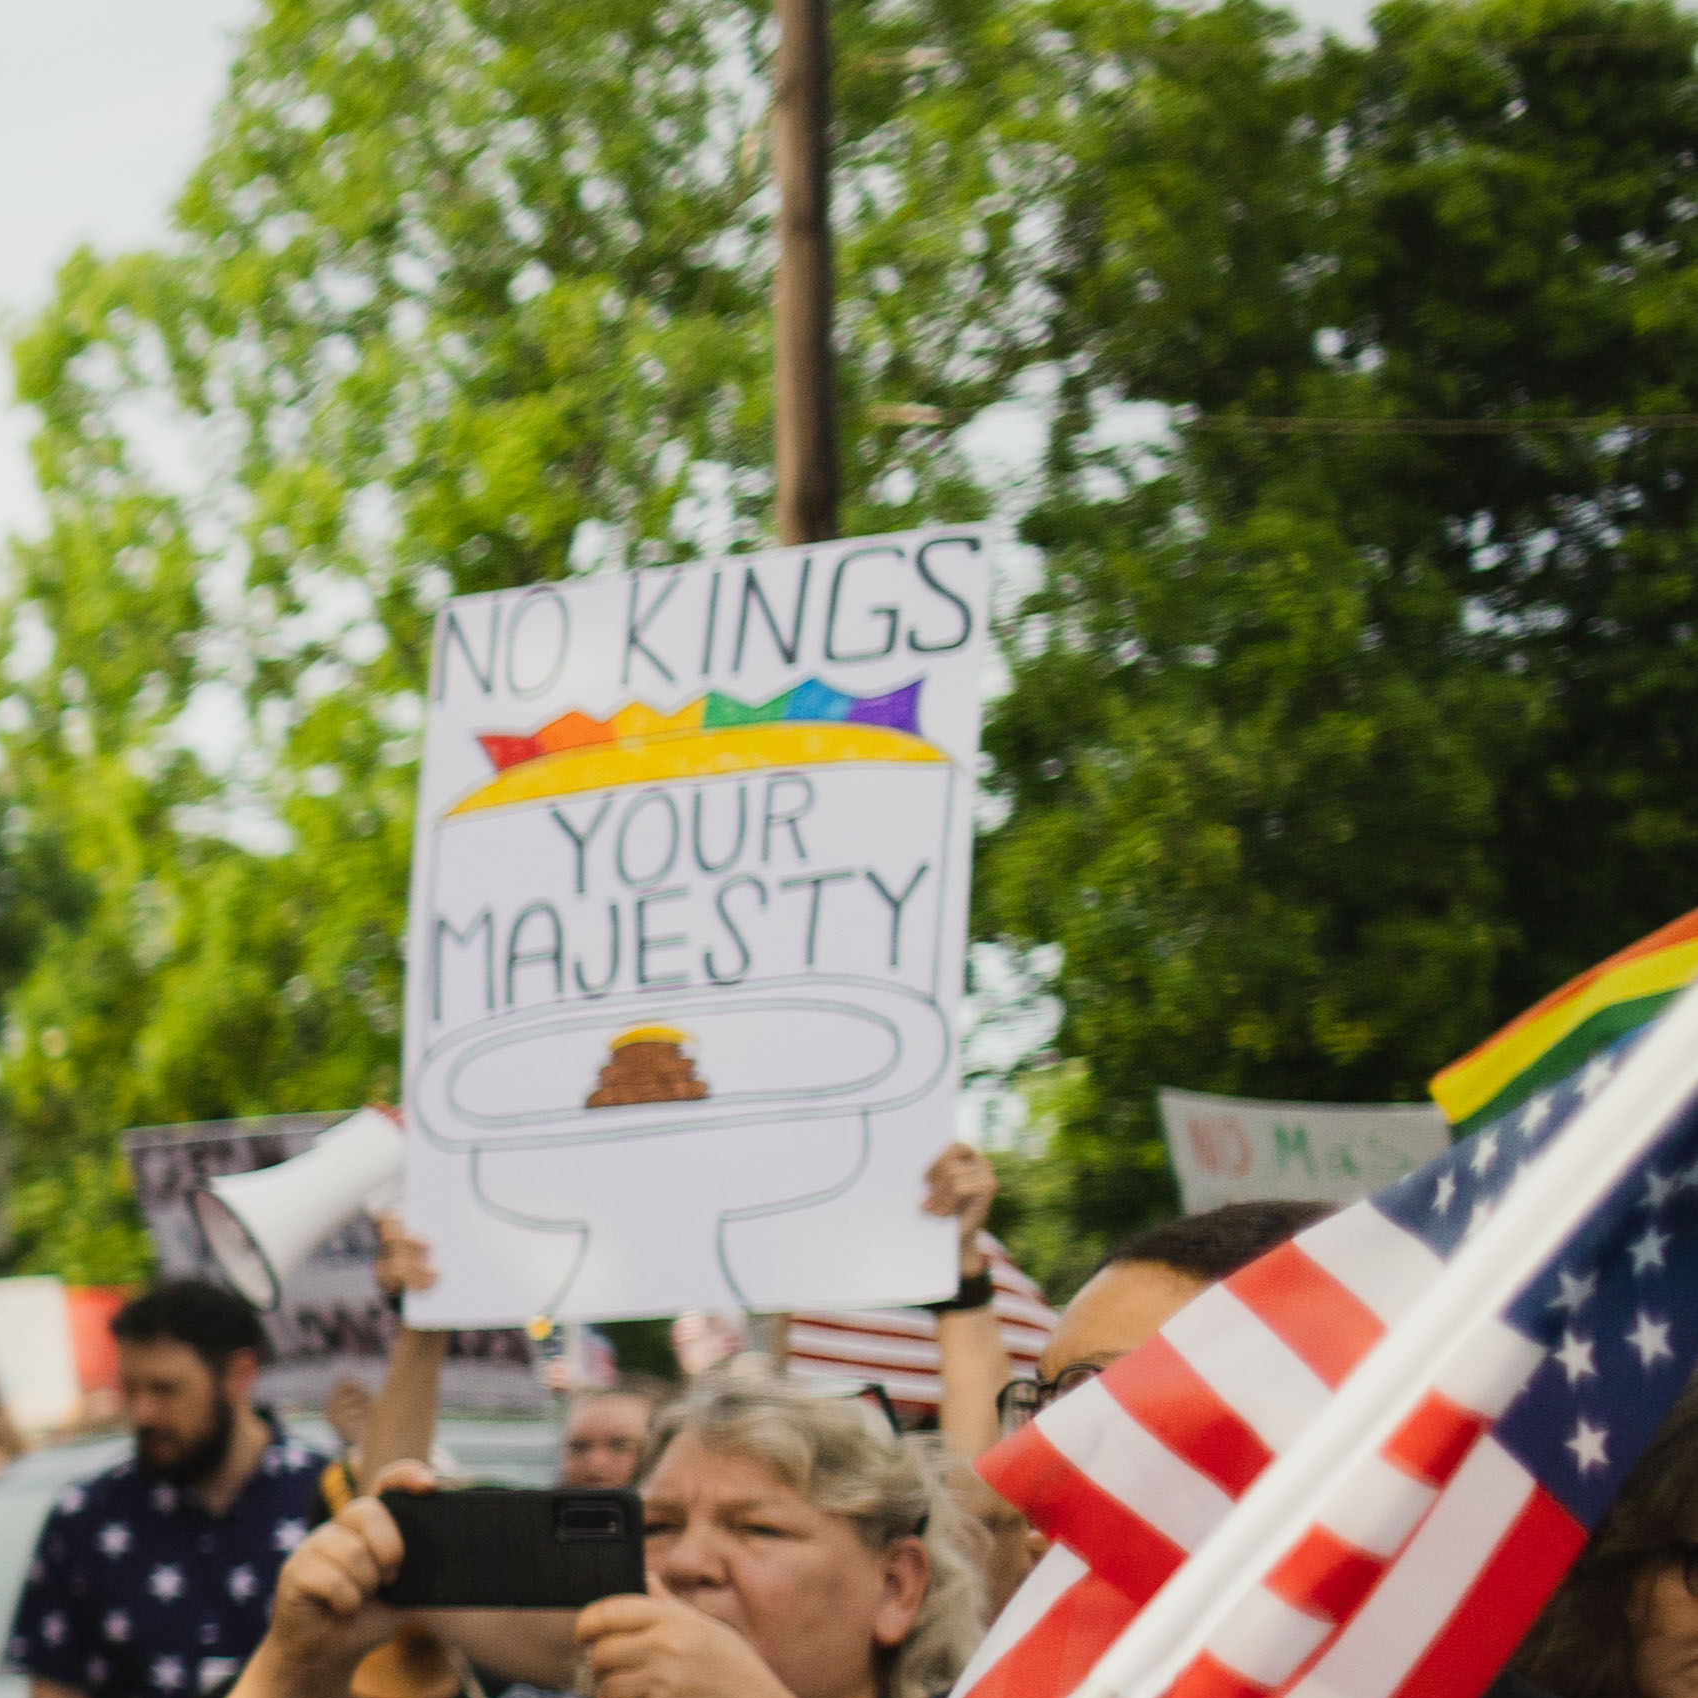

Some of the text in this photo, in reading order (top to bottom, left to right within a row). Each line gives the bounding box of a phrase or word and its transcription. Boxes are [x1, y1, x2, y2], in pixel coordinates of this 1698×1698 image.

[436, 537, 982, 702] NO KINGS
[551, 773, 815, 896] YOUR
[430, 861, 929, 1026] MAJESTY
